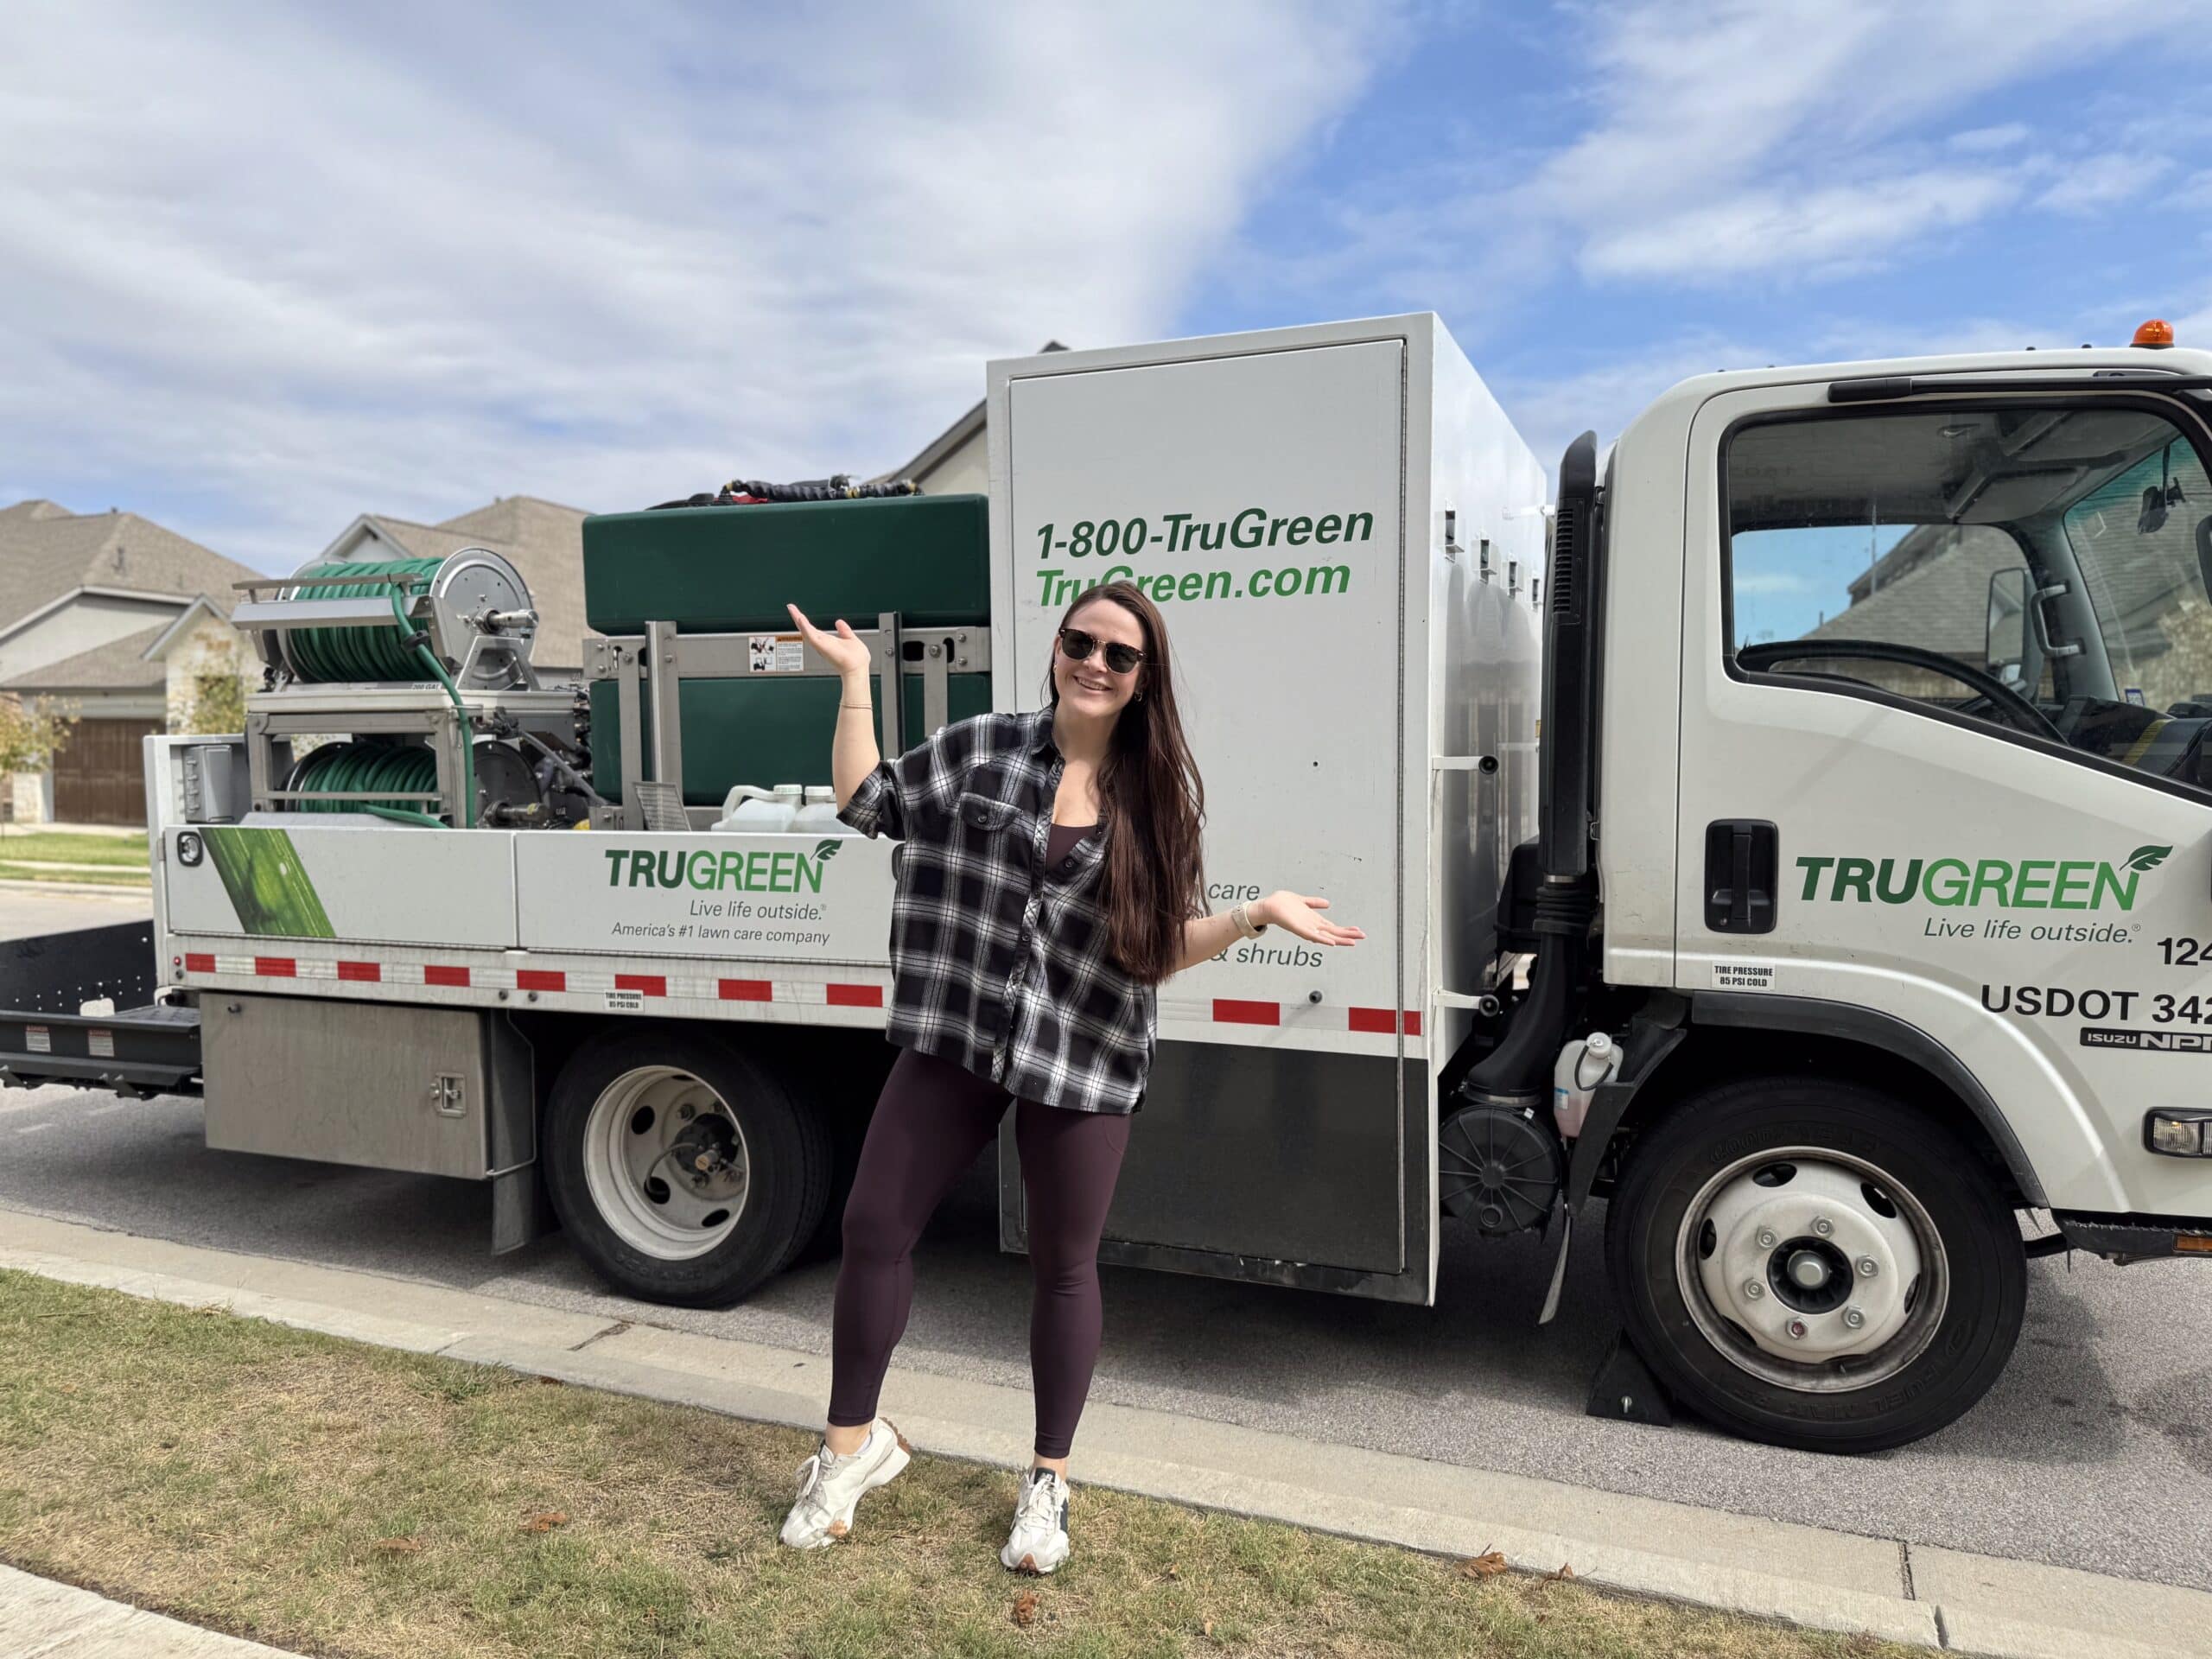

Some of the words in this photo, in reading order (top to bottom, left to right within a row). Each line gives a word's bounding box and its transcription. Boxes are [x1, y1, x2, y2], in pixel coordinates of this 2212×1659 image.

[1037, 508, 1374, 559] 1-800-TruGreen
[605, 849, 823, 893] TRUGREEN
[1209, 883, 1260, 900] care
[1796, 856, 2139, 911] TRUGREEN
[690, 899, 722, 917] Live
[728, 900, 752, 918] life
[612, 922, 675, 937] America's
[678, 925, 693, 938] #1
[698, 925, 729, 939] lawn
[734, 929, 762, 940] care
[766, 931, 830, 946] company
[1924, 918, 1974, 938] Live
[1984, 919, 2021, 939] life
[1236, 943, 1323, 967] shrubs
[1714, 965, 1732, 975] TIRE
[1733, 967, 1773, 976] PRESSURE
[1719, 976, 1731, 985] 85
[1732, 977, 1745, 986] PSI
[1746, 978, 1767, 987] COLD
[1981, 984, 2139, 1020] USDOT
[2088, 1033, 2137, 1045] ISUZU
